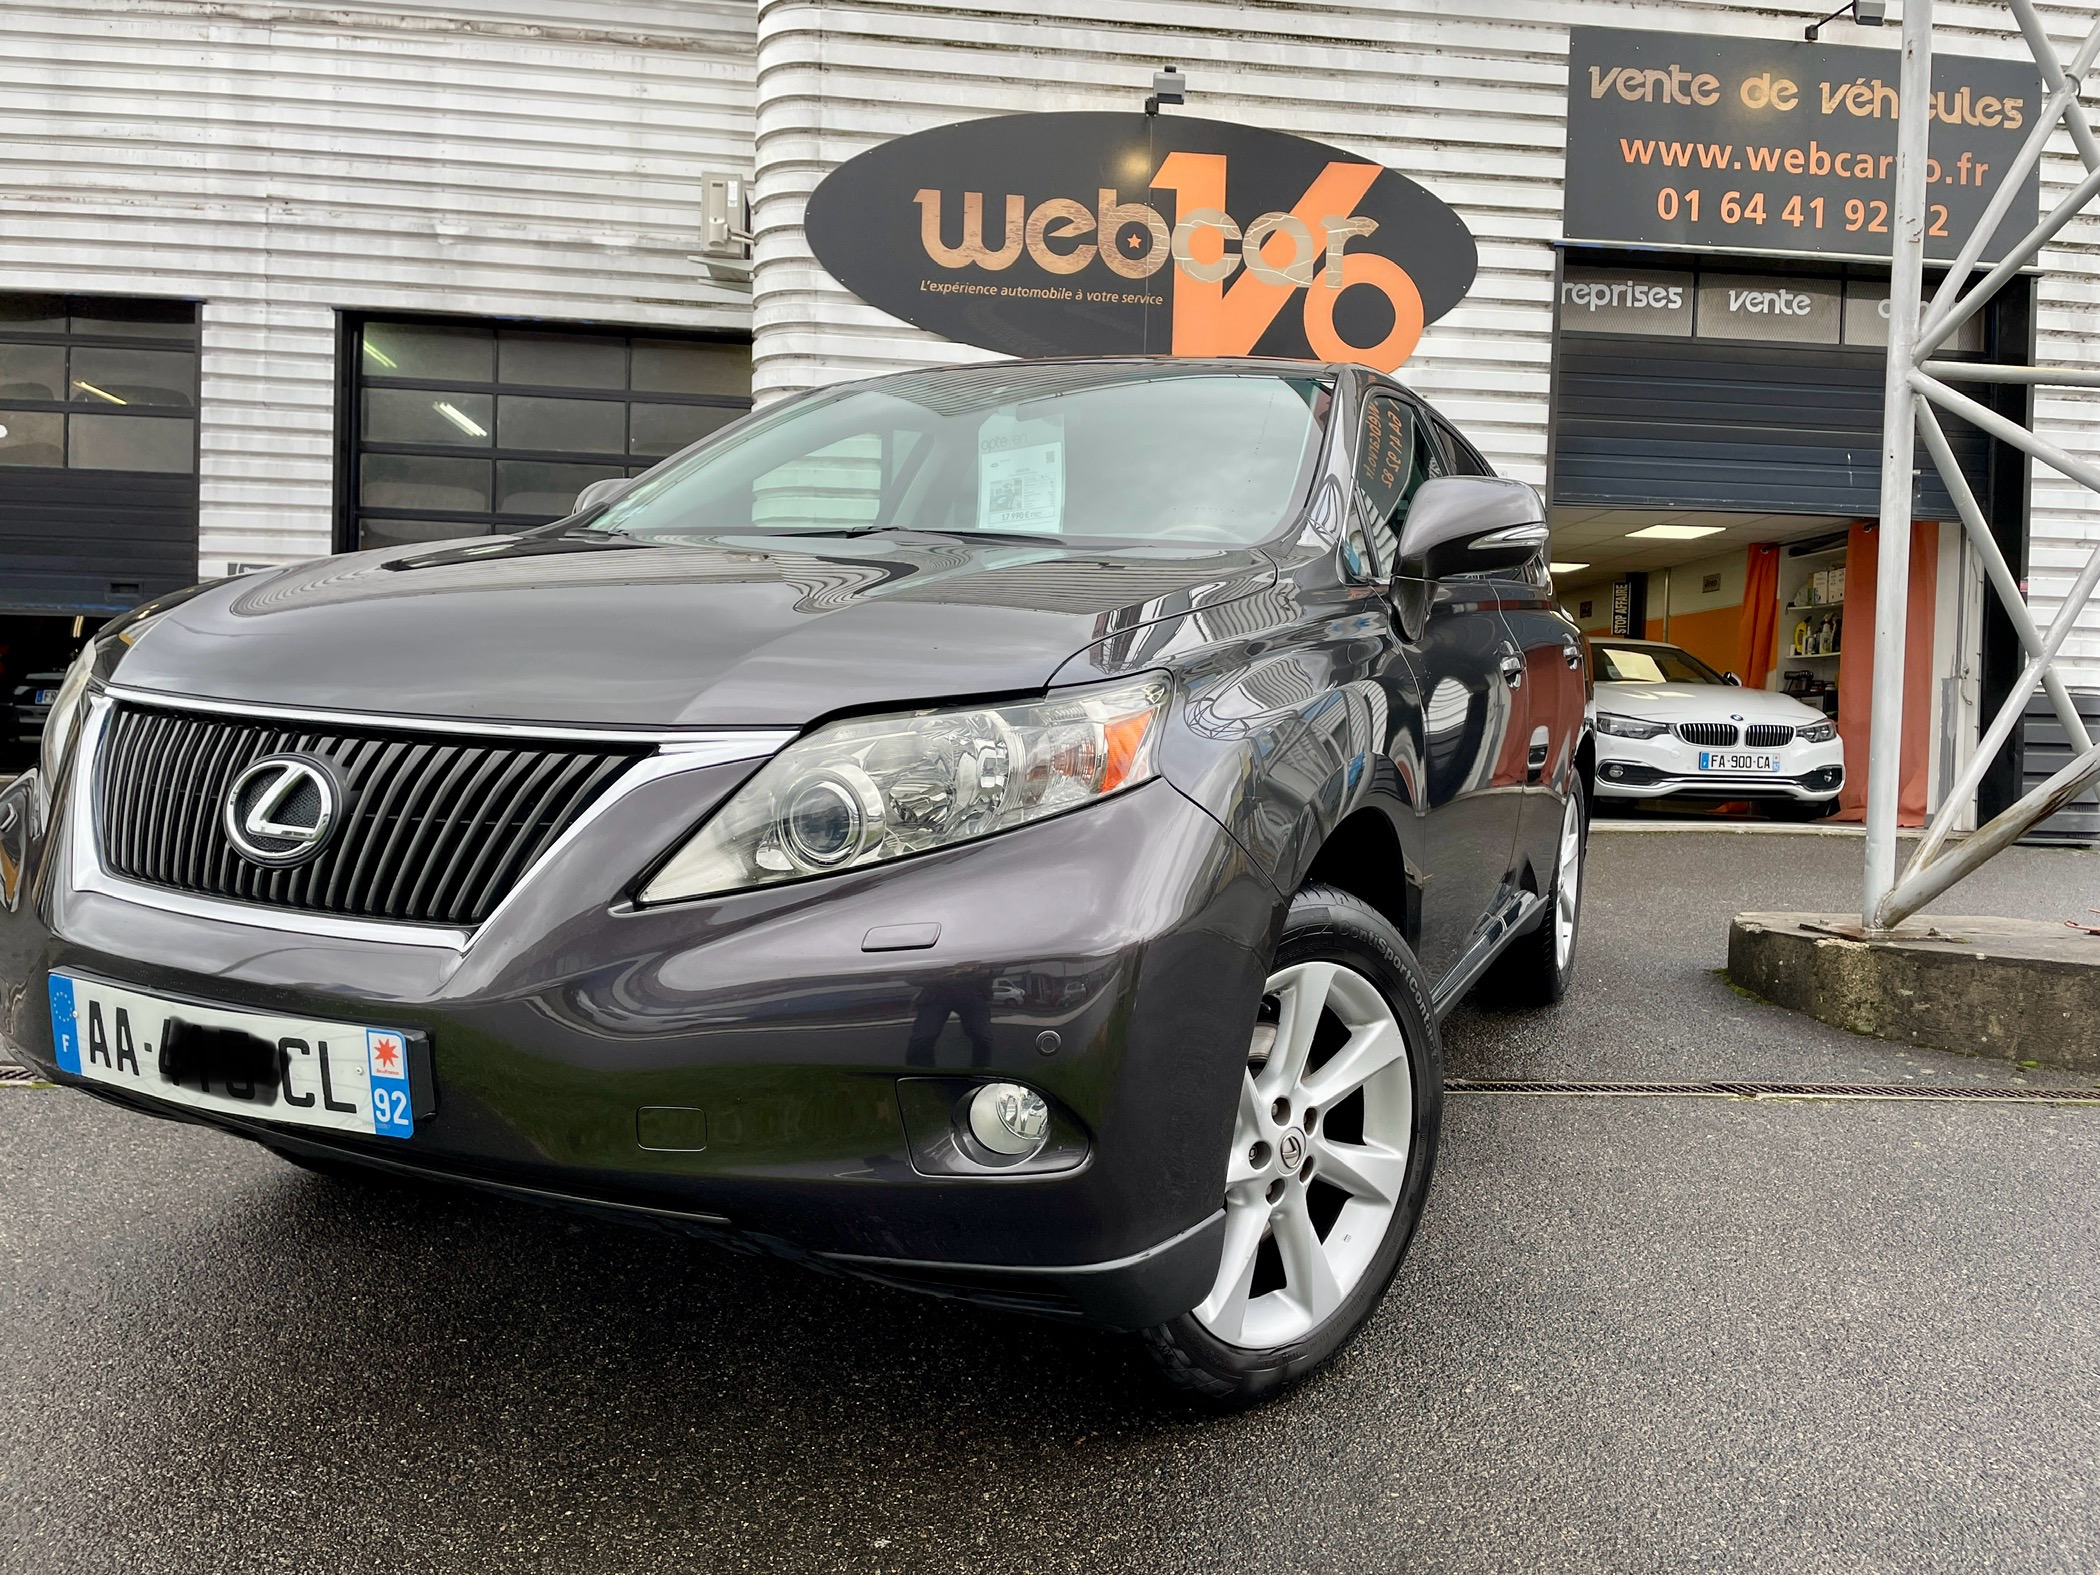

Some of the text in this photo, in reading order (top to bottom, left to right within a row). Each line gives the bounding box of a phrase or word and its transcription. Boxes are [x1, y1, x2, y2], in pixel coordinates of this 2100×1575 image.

[1589, 64, 1720, 106] vente
[1740, 73, 1798, 110] de
[1657, 188, 1698, 221] 01
[1720, 191, 1766, 225] 64
[1781, 196, 1825, 229] 41
[1845, 200, 1889, 233] 92
[913, 188, 1379, 290] webcar
[920, 280, 1163, 305] L'expérience automobile à votre service
[1562, 280, 1683, 312] reprises
[1728, 289, 1811, 315] vente
[1614, 584, 1628, 634] STOP AFFAIRE
[63, 1035, 69, 1052] F
[373, 1088, 409, 1125] 92
